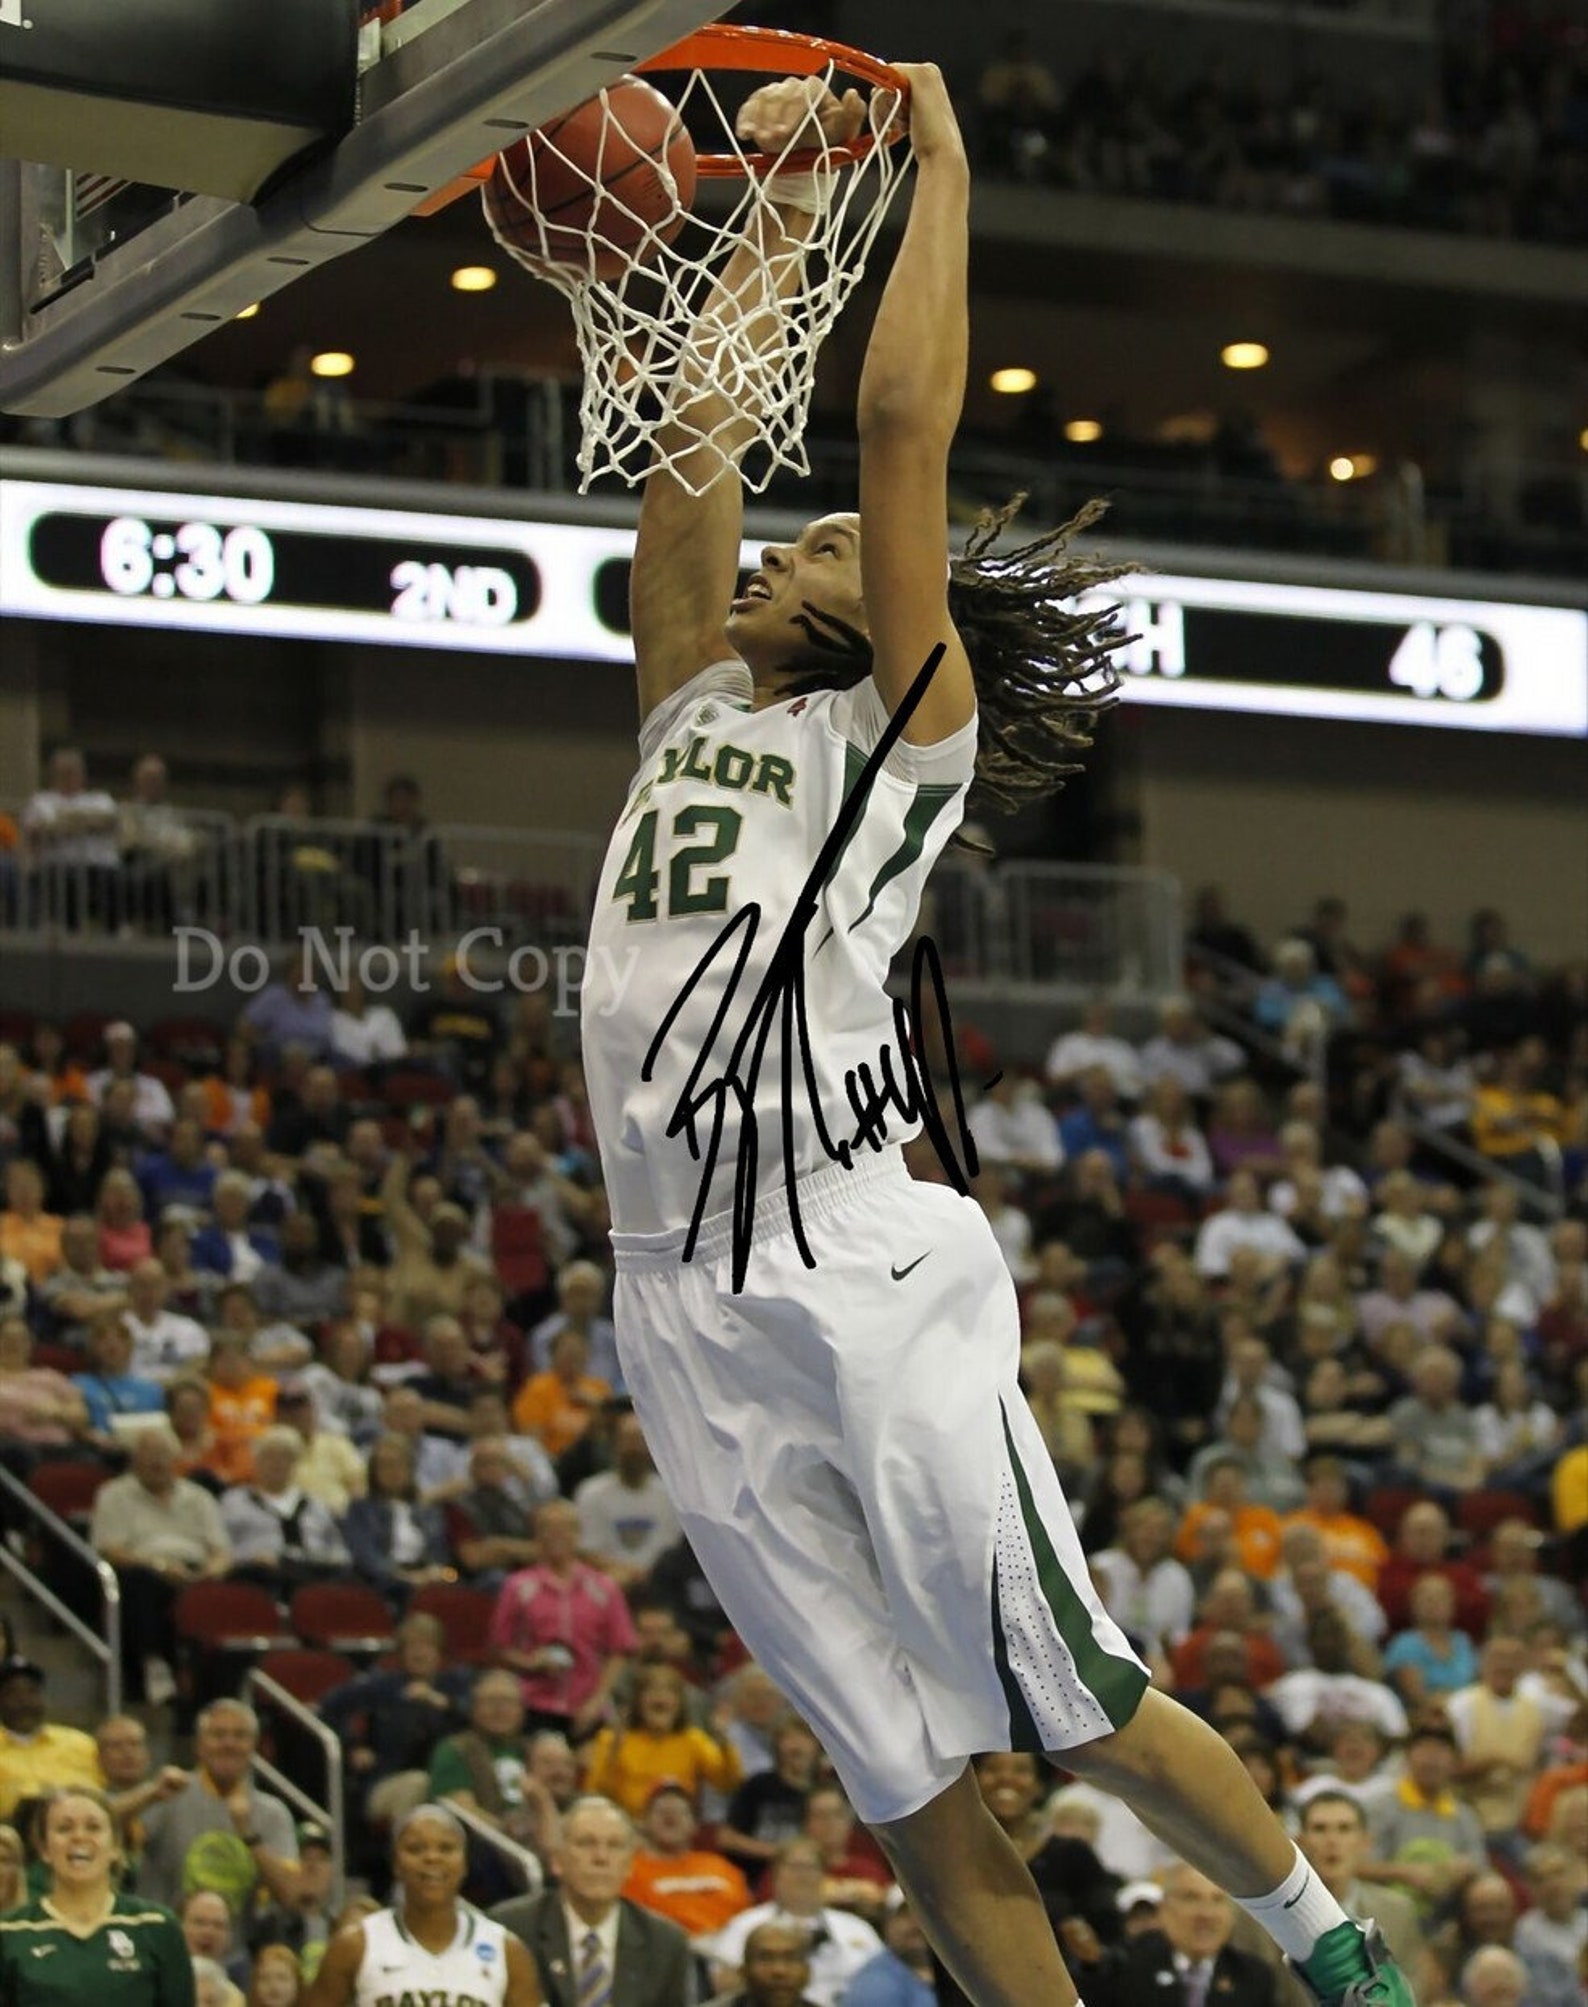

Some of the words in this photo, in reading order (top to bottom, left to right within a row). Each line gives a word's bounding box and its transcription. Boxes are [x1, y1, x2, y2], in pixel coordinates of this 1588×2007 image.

[100, 516, 274, 603] 6:30
[389, 560, 517, 625] 2ND
[619, 736, 797, 811] YLOR
[612, 804, 742, 923] 42
